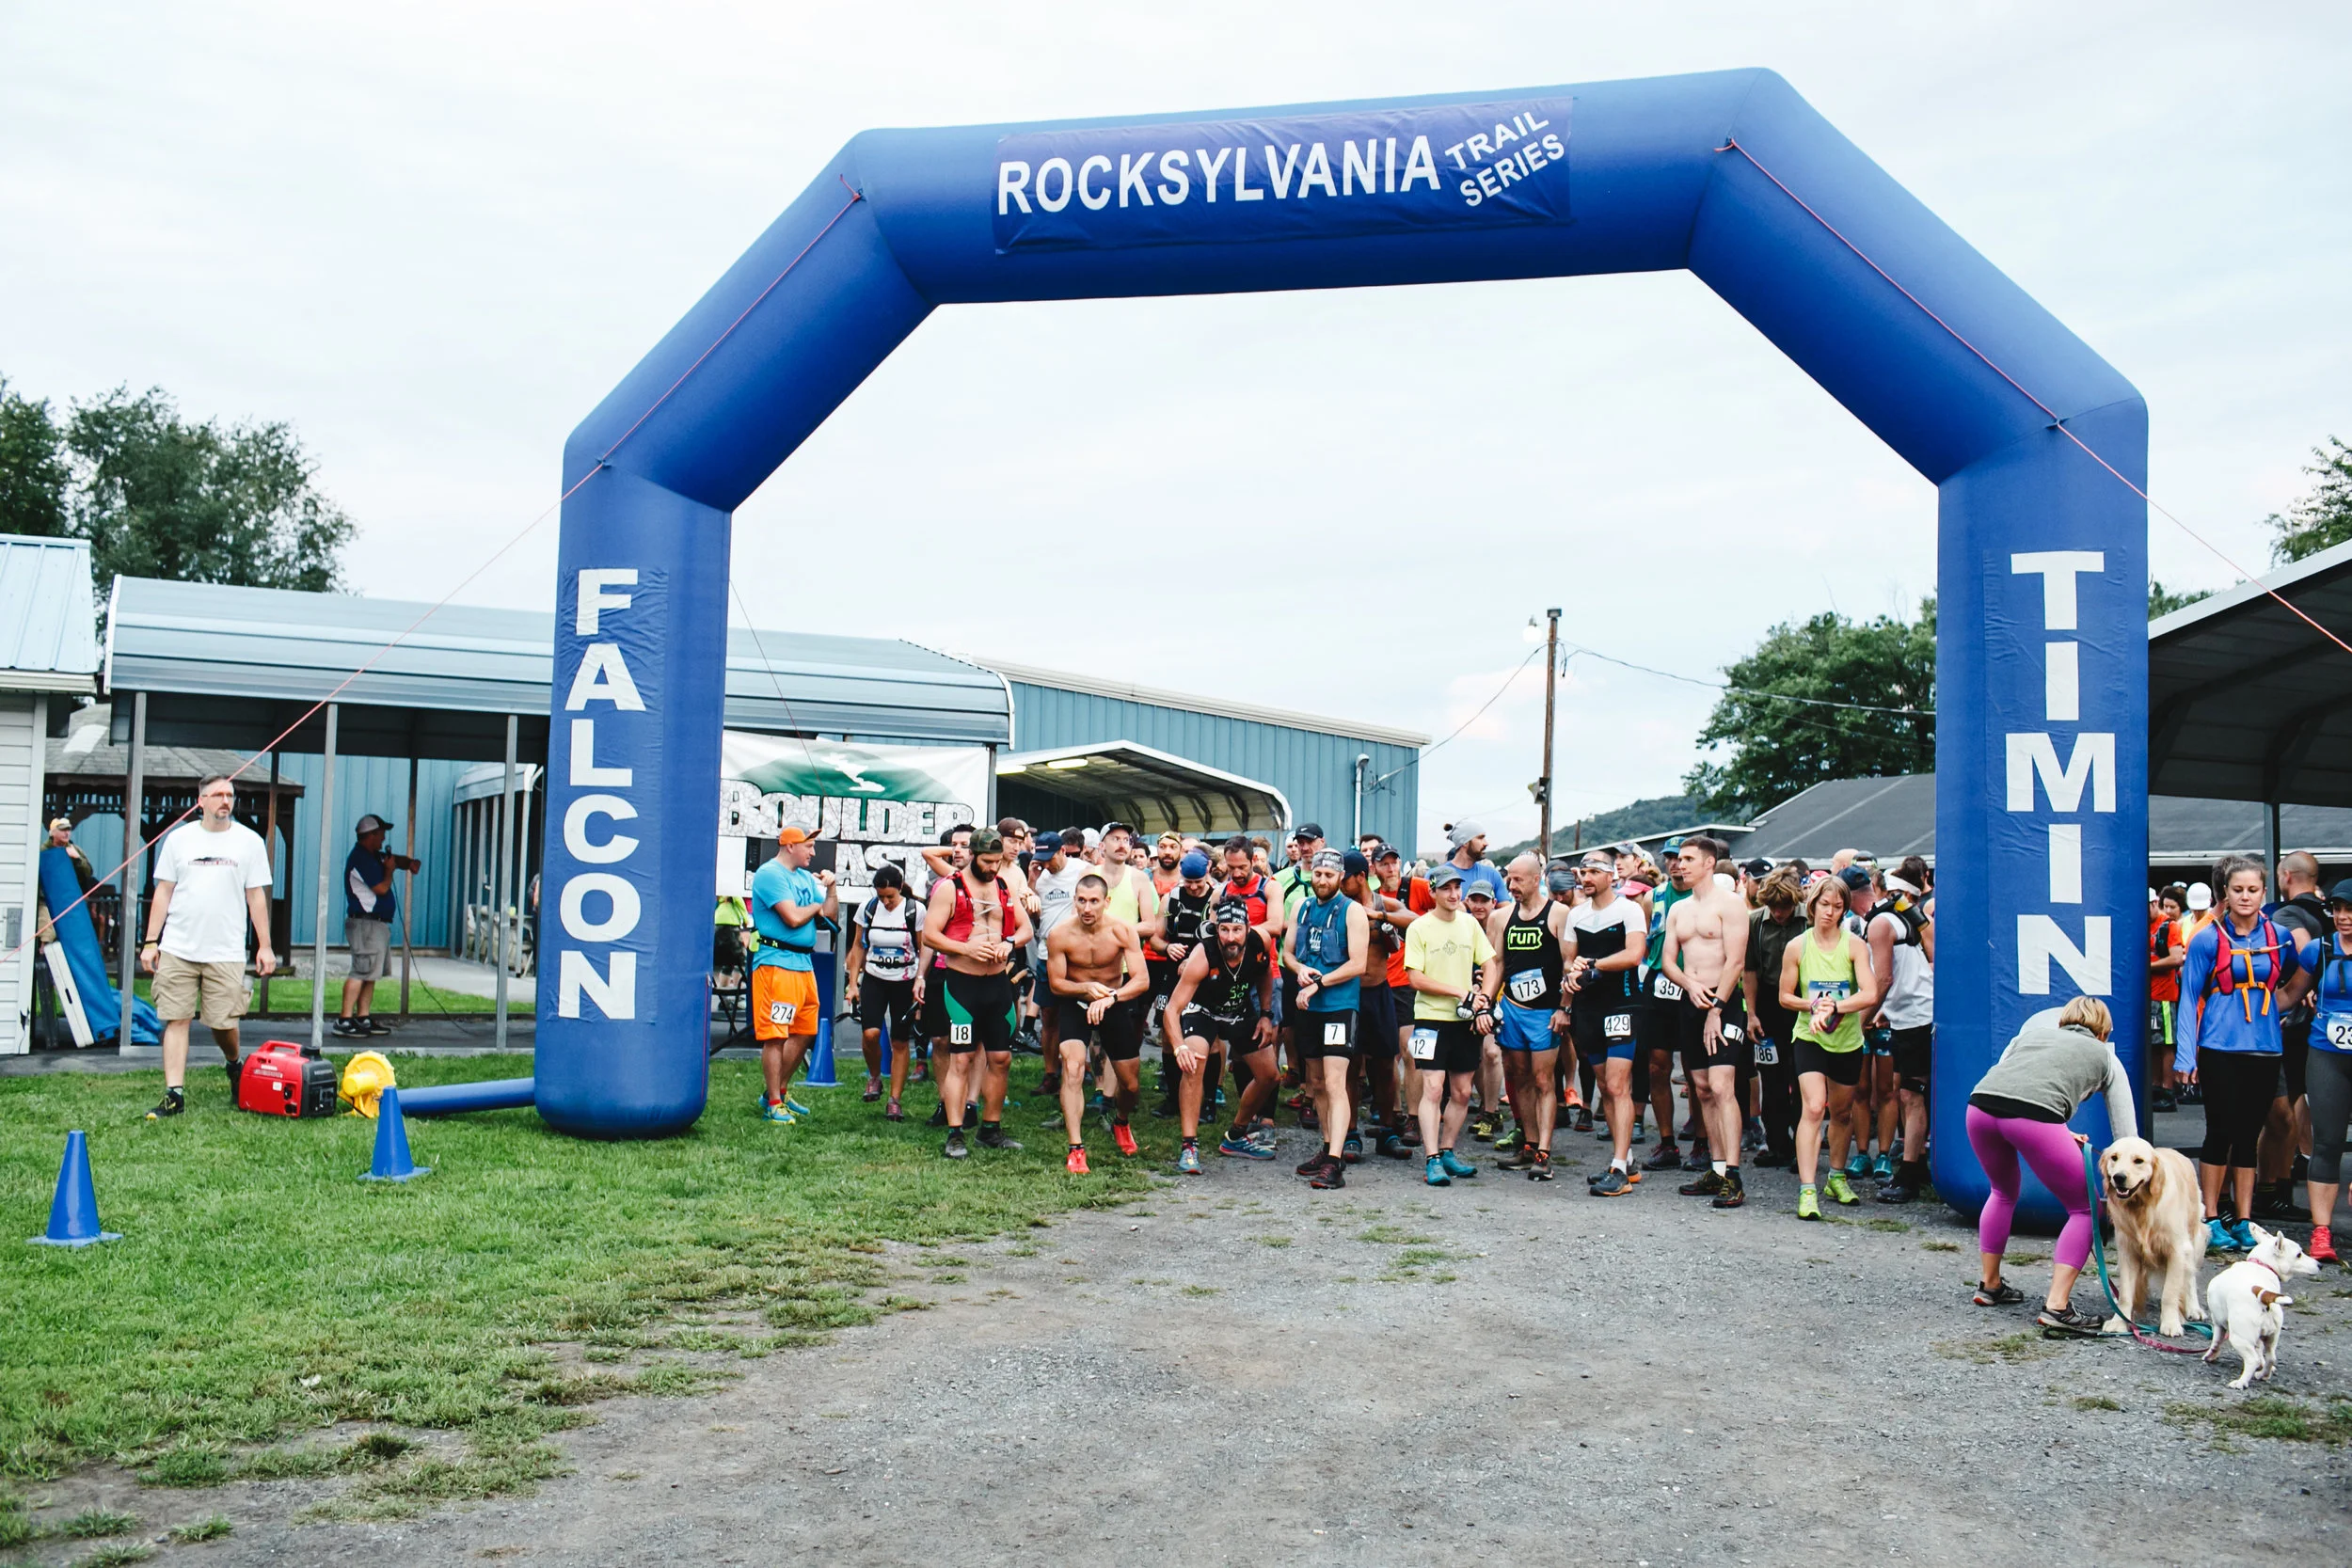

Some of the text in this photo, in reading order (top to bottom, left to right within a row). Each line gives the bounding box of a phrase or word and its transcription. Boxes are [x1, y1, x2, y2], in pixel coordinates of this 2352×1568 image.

[1444, 111, 1549, 171] TRAIL
[998, 135, 1441, 215] ROCKSYLVANIA
[1459, 133, 1565, 207] SERIES
[558, 567, 646, 1021] FALCON
[2005, 550, 2116, 1036] TIMIN
[1510, 932, 1536, 944] run
[1517, 979, 1541, 999] 173
[771, 1005, 793, 1022] 274
[955, 1025, 969, 1040] 18
[1331, 1024, 1338, 1040] 7
[1605, 1016, 1629, 1032] 429
[1414, 1038, 1425, 1054] 12
[1755, 1045, 1773, 1062] 186
